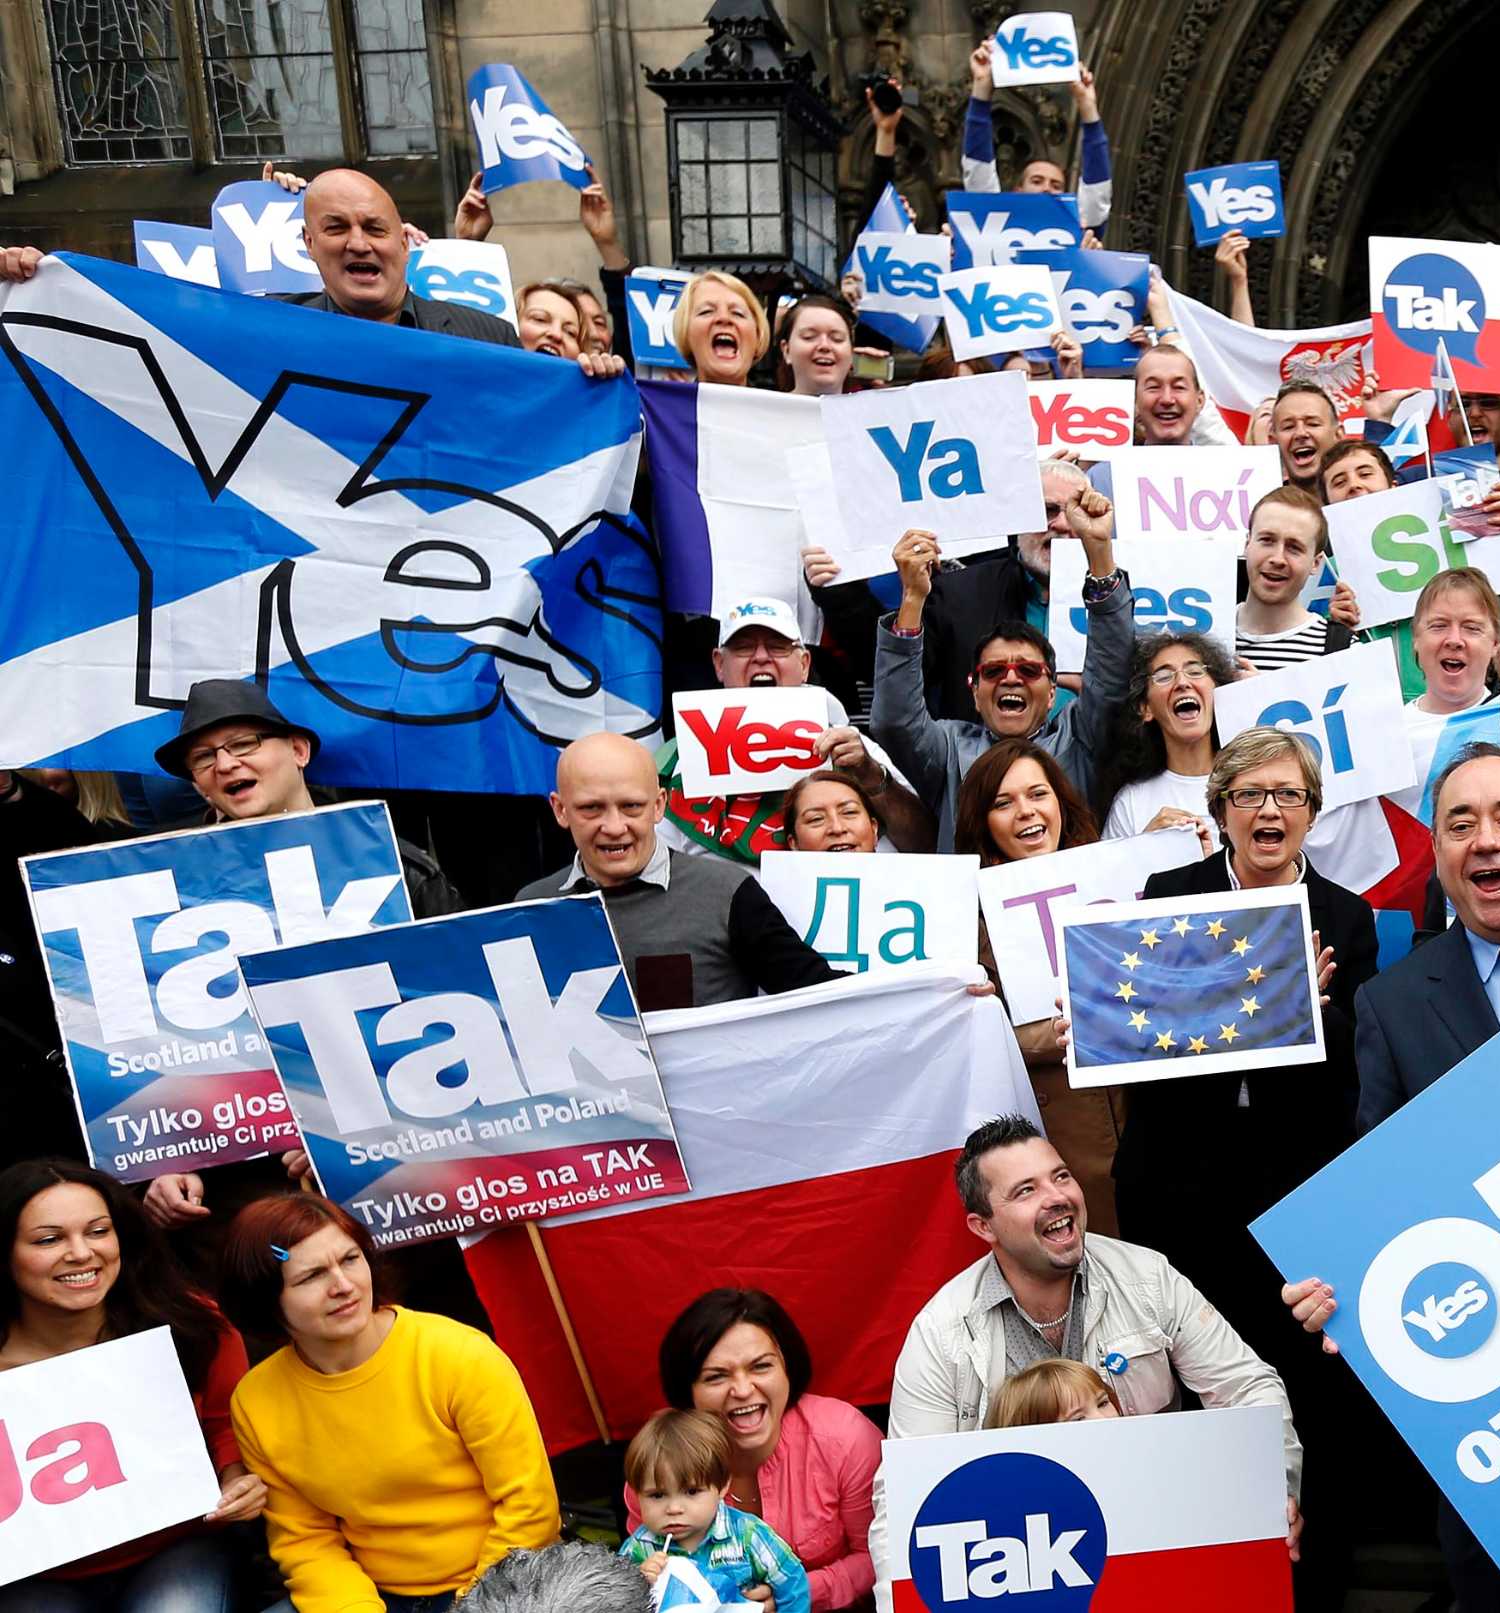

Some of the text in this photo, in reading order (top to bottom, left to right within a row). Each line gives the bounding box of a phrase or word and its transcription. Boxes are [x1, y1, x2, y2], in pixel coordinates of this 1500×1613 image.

[995, 27, 1076, 70] Yes
[472, 86, 590, 171] Yes
[1189, 177, 1277, 228] Yes
[217, 202, 322, 275] Ye
[857, 246, 943, 299] Yes
[405, 250, 507, 315] es
[944, 282, 1054, 338] Yes
[1050, 271, 1135, 344] es
[1384, 284, 1480, 333] Tak
[1029, 393, 1131, 447] Yes
[867, 420, 985, 502] Ya
[0, 311, 664, 748] Yes
[678, 706, 827, 776] Yes
[1256, 682, 1354, 774] Sí
[33, 845, 401, 1043] Tak
[803, 876, 932, 974] Да
[107, 1031, 238, 1078] Scotland
[249, 936, 656, 1134] Tak
[107, 1091, 287, 1147] Tylko glos
[114, 1132, 229, 1172] gwarantuje
[235, 1125, 256, 1144] Ci
[345, 1088, 634, 1167] Scotland and Poland
[353, 1143, 655, 1229] Tylko glos na TAK
[614, 1180, 631, 1196] w
[637, 1173, 665, 1191] UE
[1402, 1278, 1489, 1343] Yes
[915, 1513, 1094, 1603] Tak
